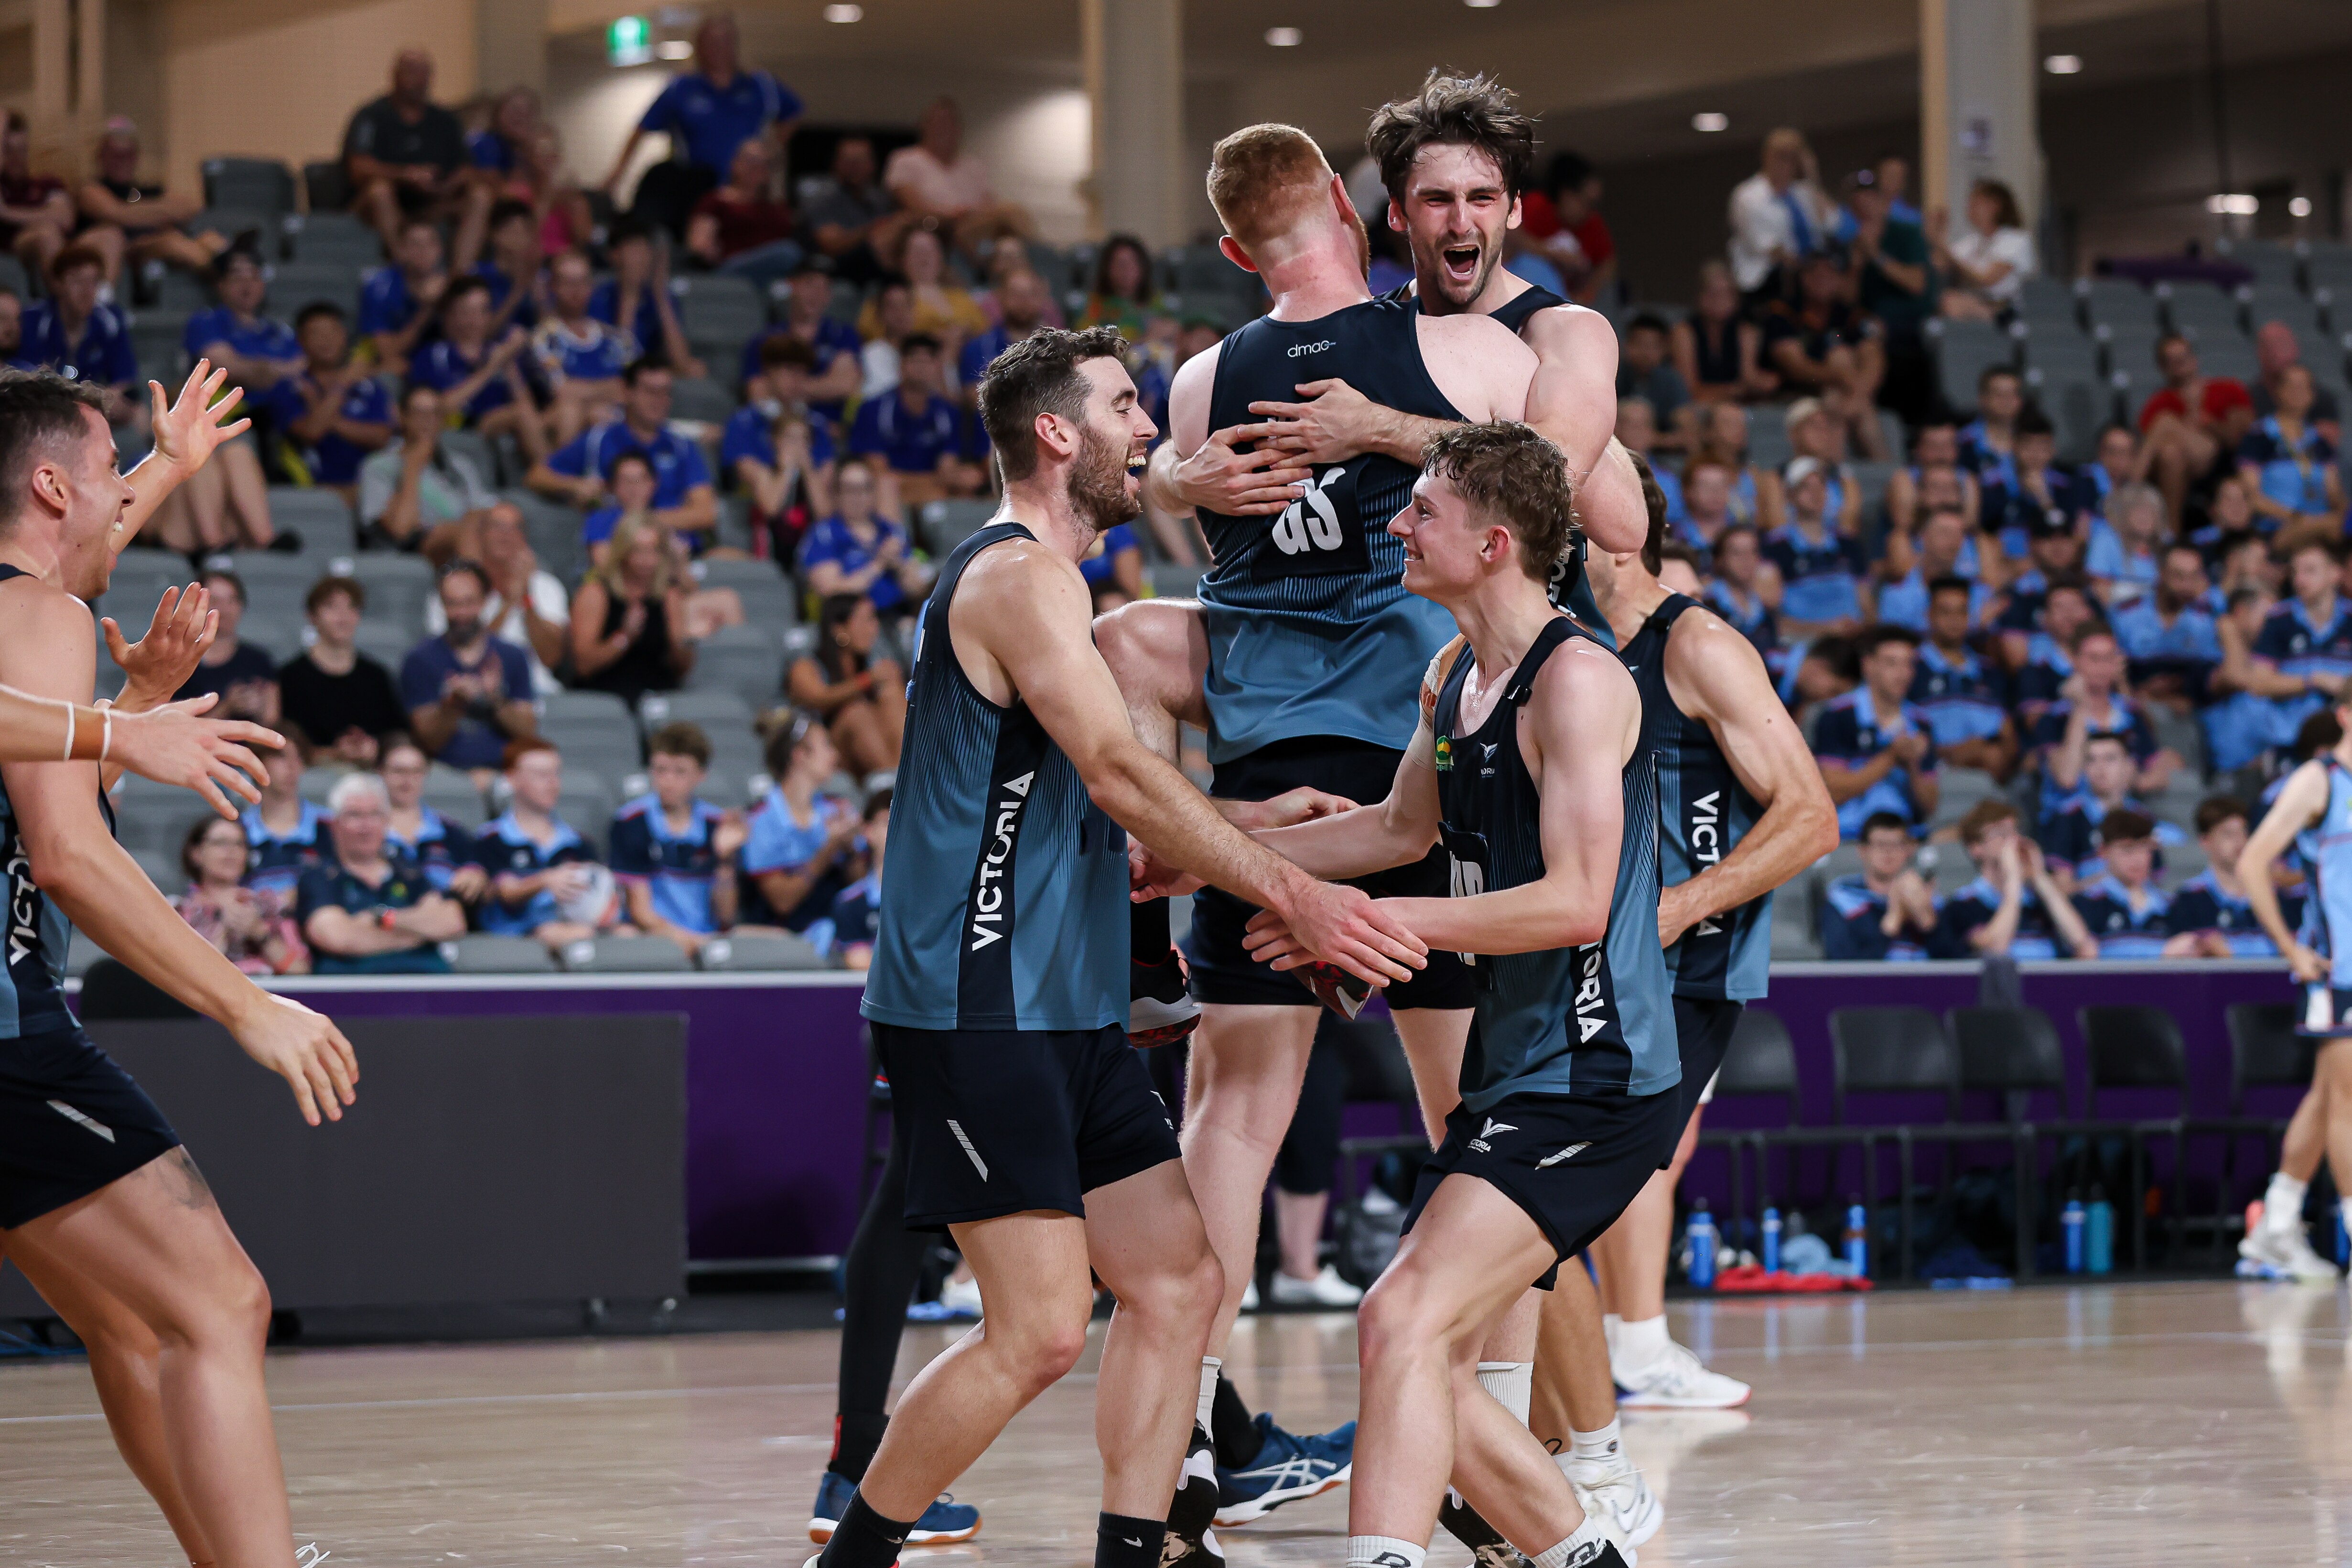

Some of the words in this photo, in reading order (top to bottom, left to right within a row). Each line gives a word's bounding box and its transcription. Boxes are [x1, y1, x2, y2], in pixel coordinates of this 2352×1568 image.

[7, 833, 37, 966] VICTO
[972, 771, 1035, 951] VICTORIA
[1692, 790, 1723, 937] VICTA
[1575, 937, 1608, 1044] TORIA
